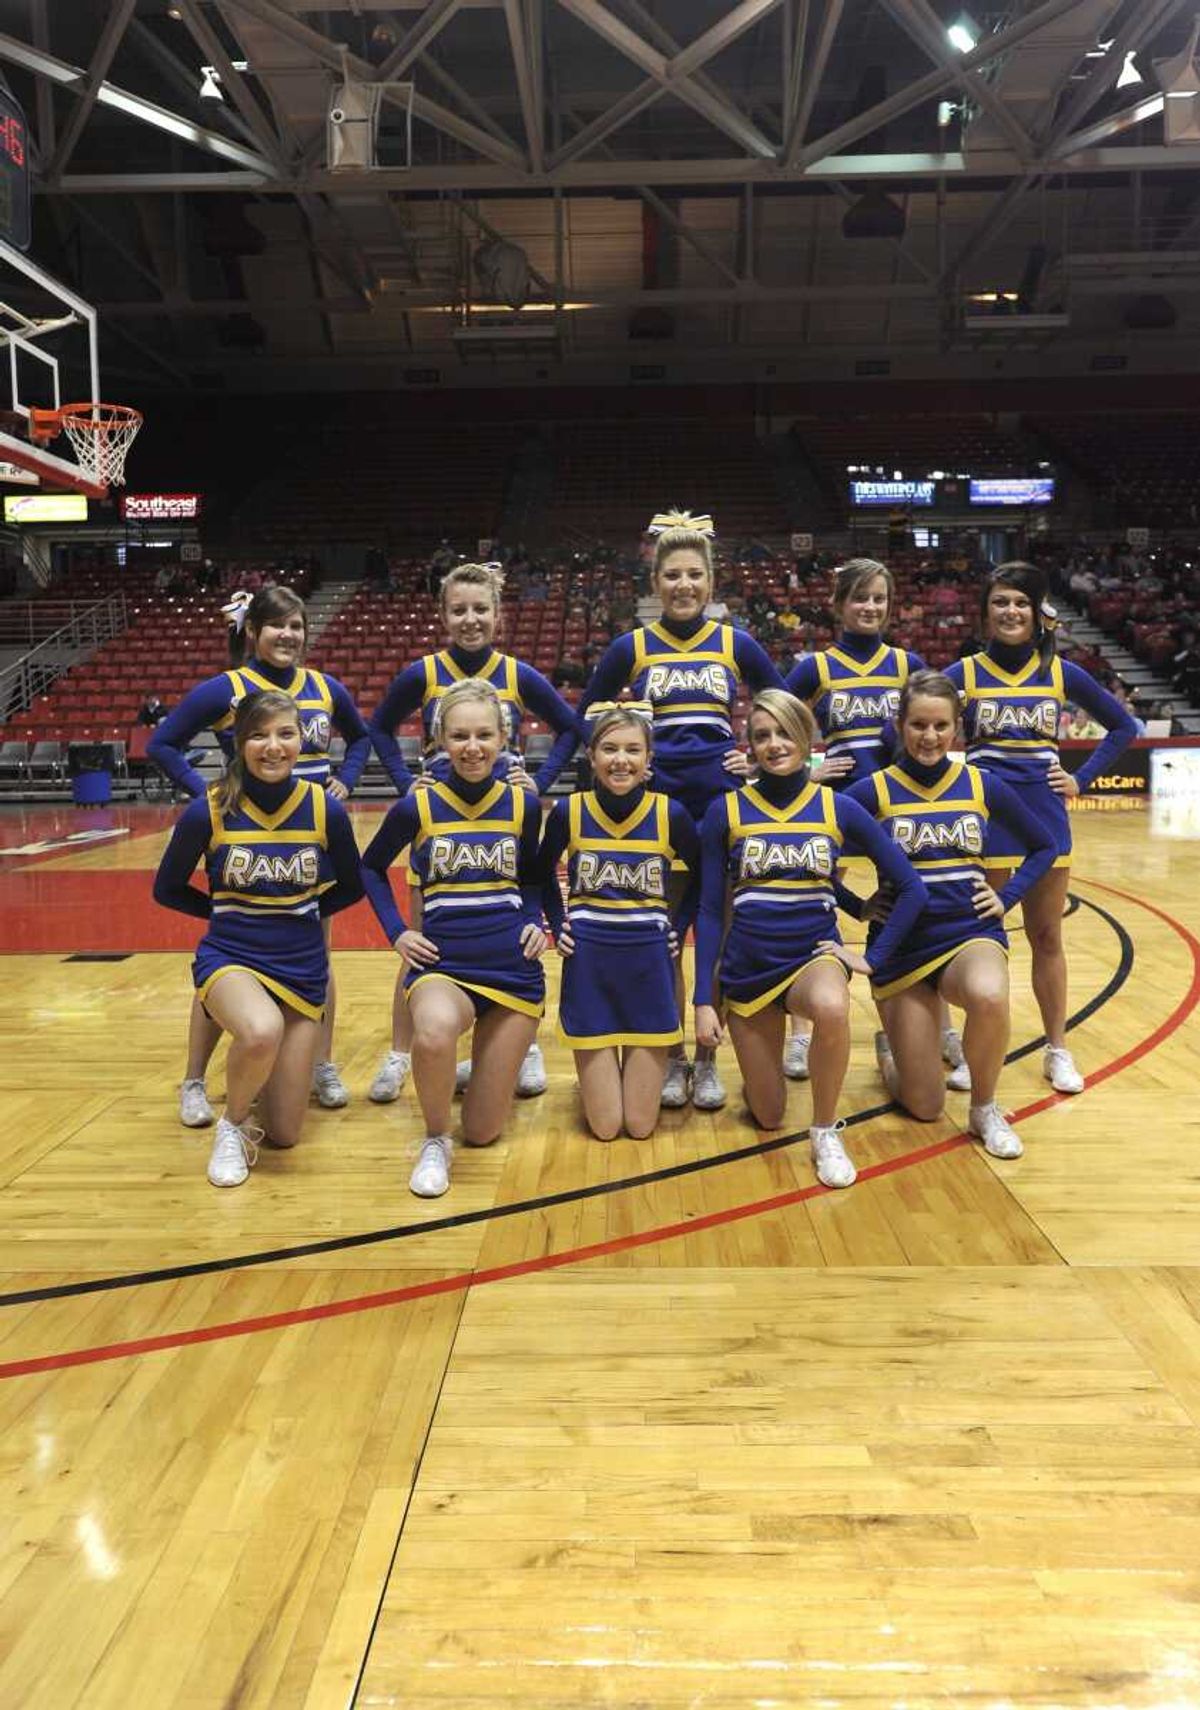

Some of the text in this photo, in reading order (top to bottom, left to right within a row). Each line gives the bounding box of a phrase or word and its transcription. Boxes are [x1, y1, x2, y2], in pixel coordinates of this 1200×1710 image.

[125, 496, 197, 511] Southeast
[645, 664, 729, 700] RAMS
[300, 713, 330, 750] MS
[975, 701, 1057, 740] RAMS
[893, 814, 983, 855] RAMS
[223, 845, 318, 887] RAMS
[429, 836, 517, 879] RAMS
[575, 853, 665, 896] RAMS
[740, 837, 833, 877] RAMS
